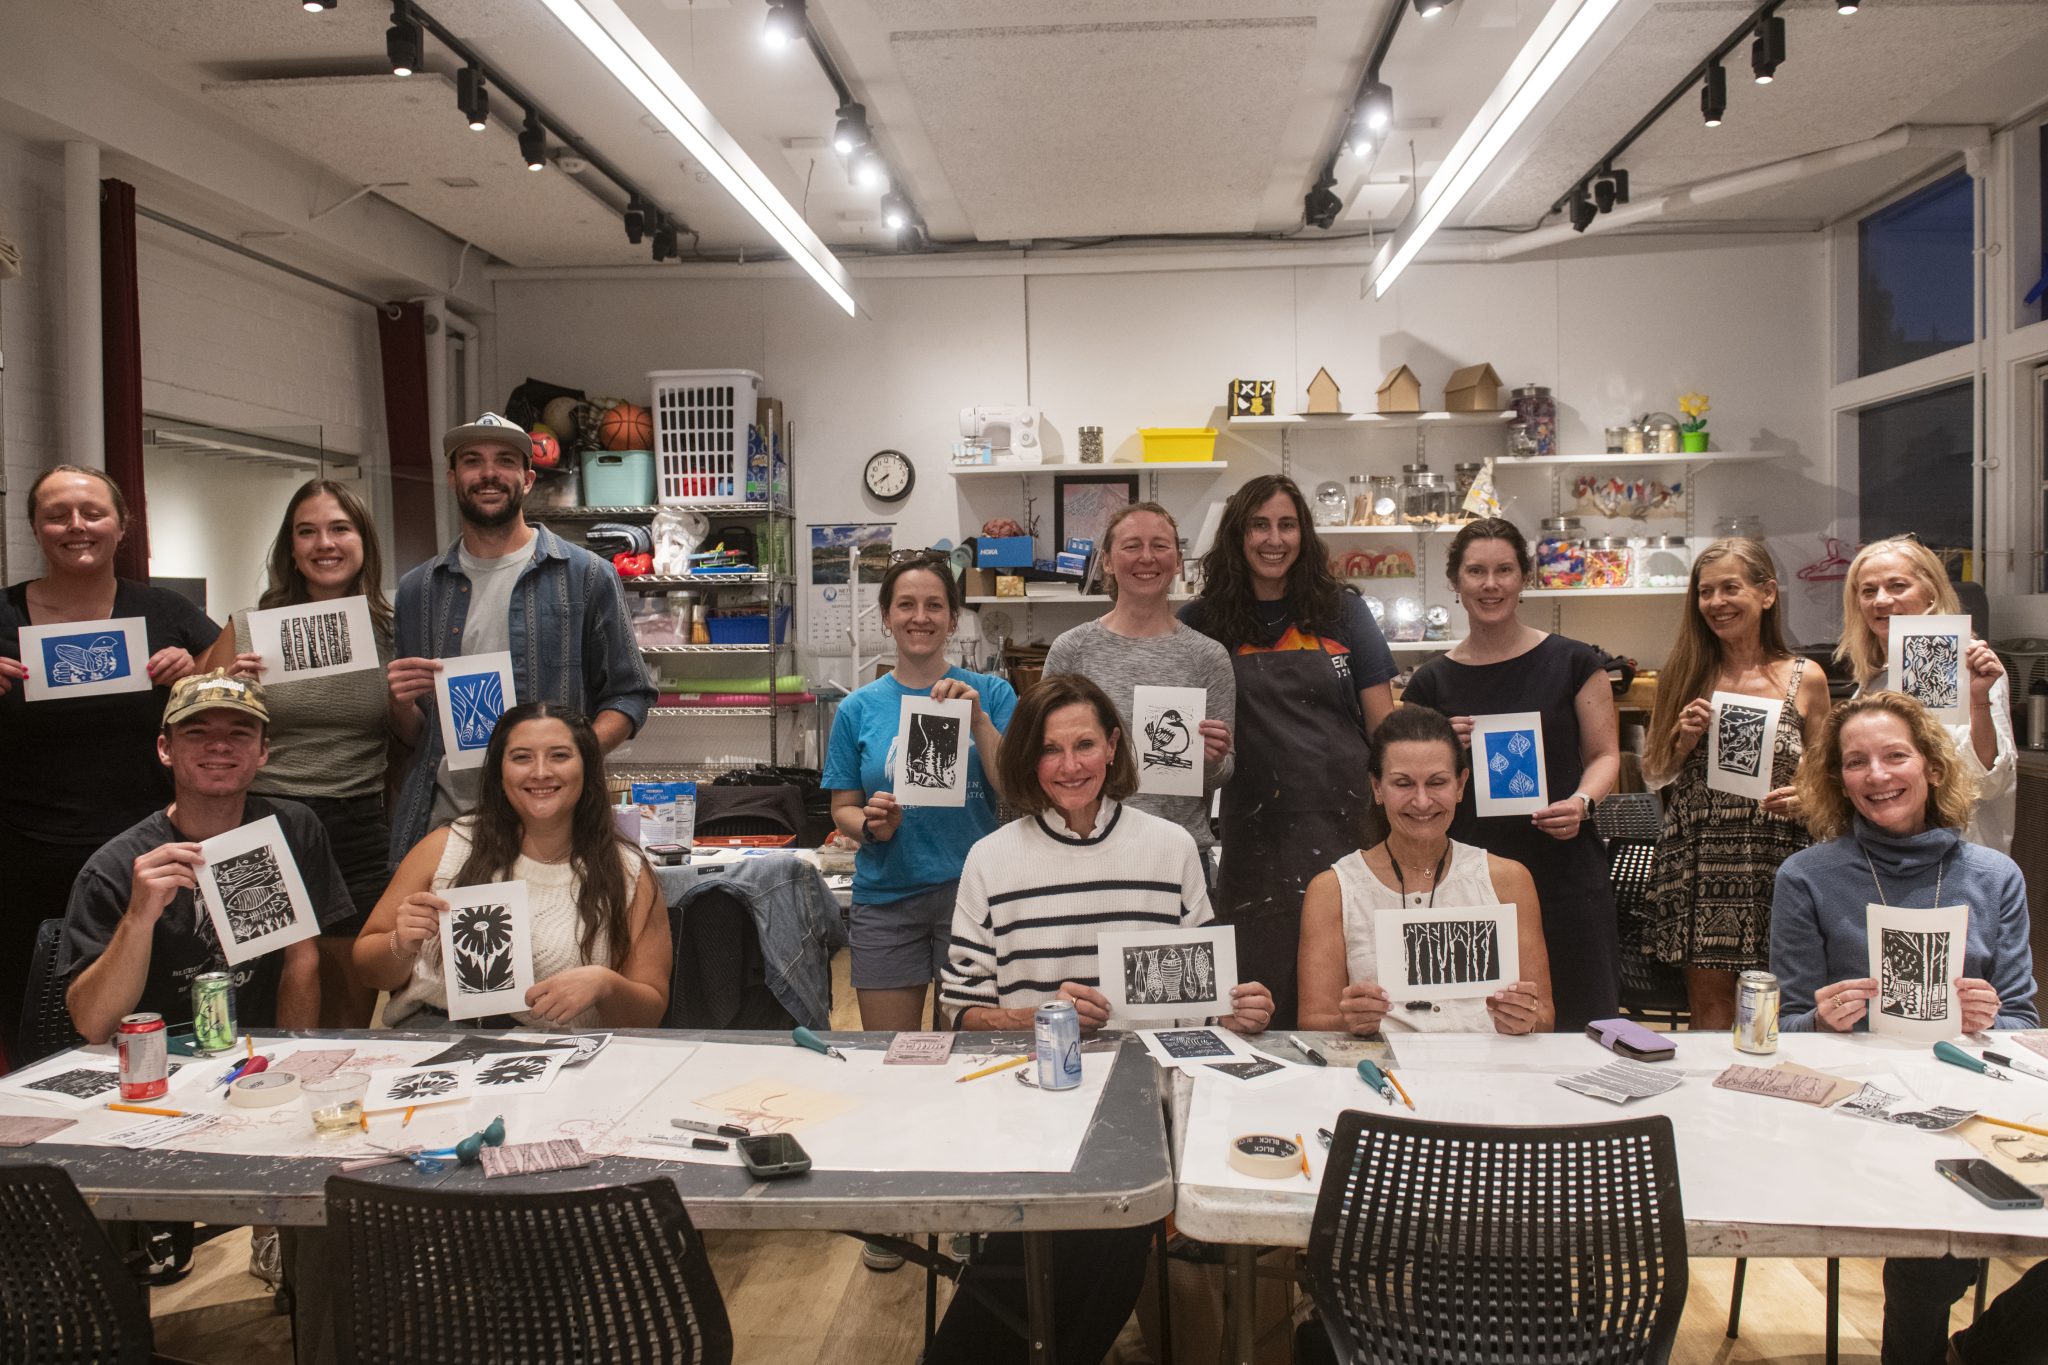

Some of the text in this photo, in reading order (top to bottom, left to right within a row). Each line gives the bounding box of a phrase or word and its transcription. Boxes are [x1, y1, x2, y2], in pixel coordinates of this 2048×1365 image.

[980, 548, 999, 556] HOKA
[1259, 1137, 1280, 1146] BLICK
[1253, 1145, 1275, 1153] BLICK
